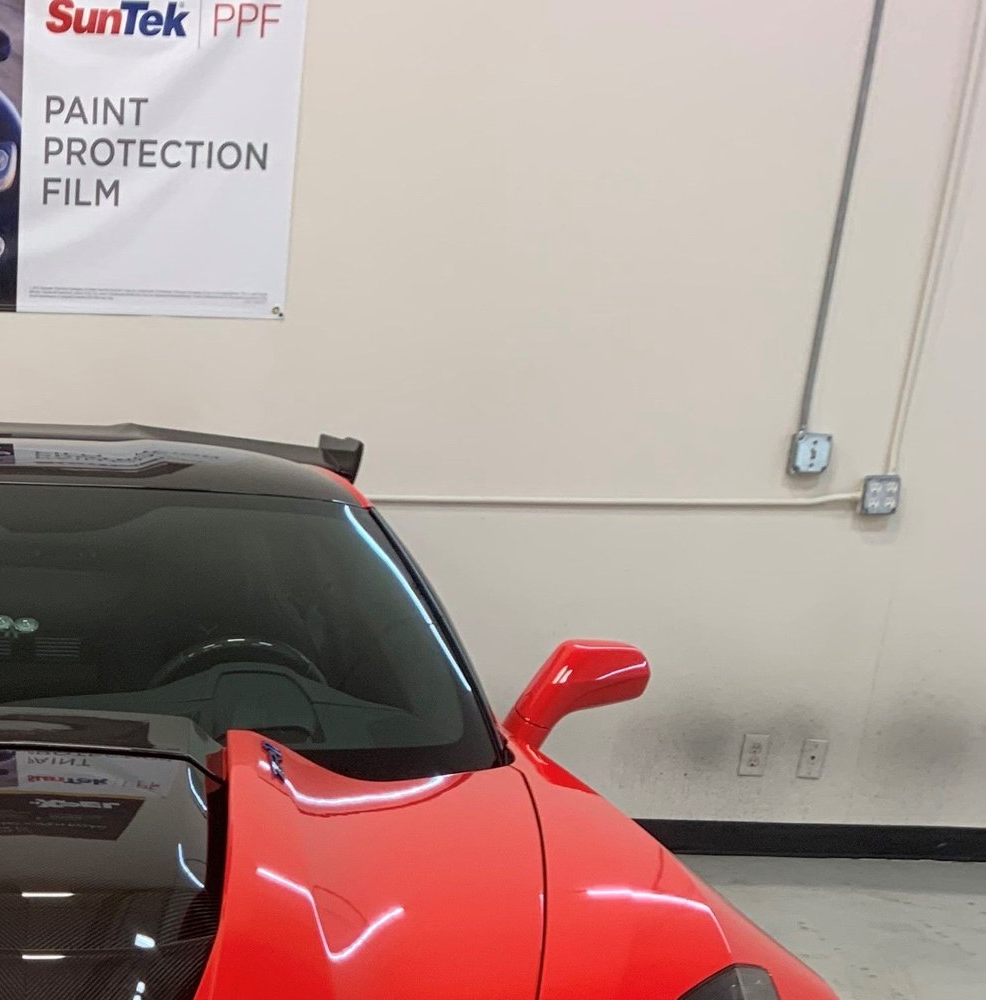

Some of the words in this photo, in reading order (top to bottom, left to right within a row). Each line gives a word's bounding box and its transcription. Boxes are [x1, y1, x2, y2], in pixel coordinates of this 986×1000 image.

[45, 0, 190, 37] SunTek
[213, 3, 282, 38] PPF
[45, 95, 149, 126] PAINT
[44, 136, 268, 170] PROTECTION
[42, 177, 120, 207] FILM
